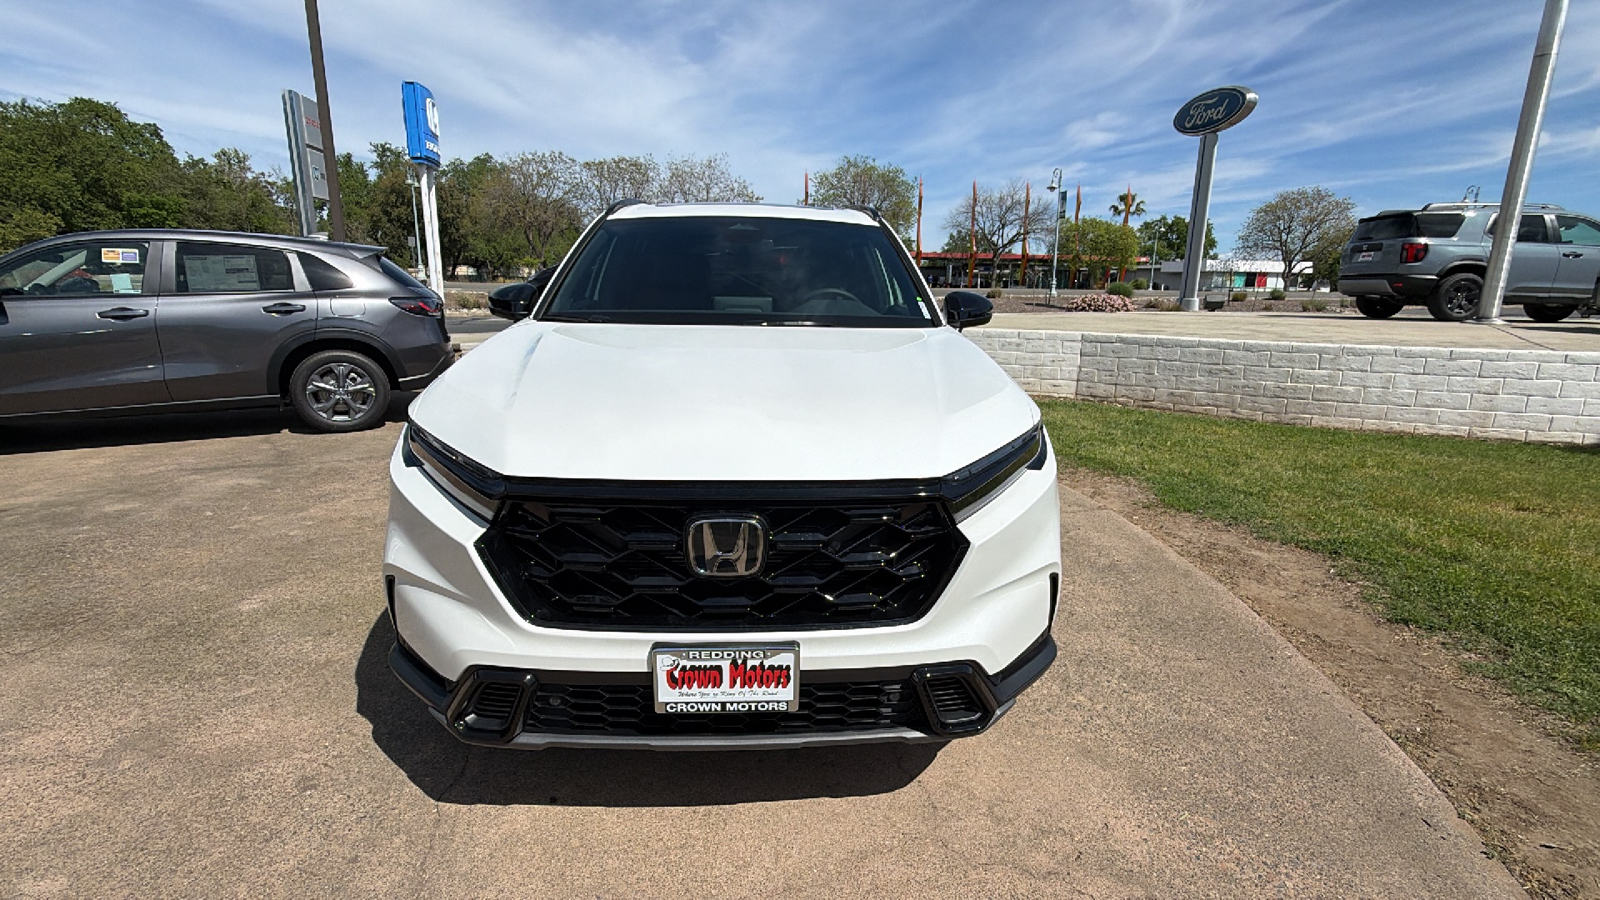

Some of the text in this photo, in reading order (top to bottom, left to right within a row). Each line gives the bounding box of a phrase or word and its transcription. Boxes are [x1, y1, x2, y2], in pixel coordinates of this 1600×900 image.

[1185, 97, 1229, 128] Ford
[689, 651, 764, 659] REDDING
[666, 659, 791, 690] Crown Motors
[720, 691, 736, 699] King
[666, 701, 788, 712] CROWN MOTORS
